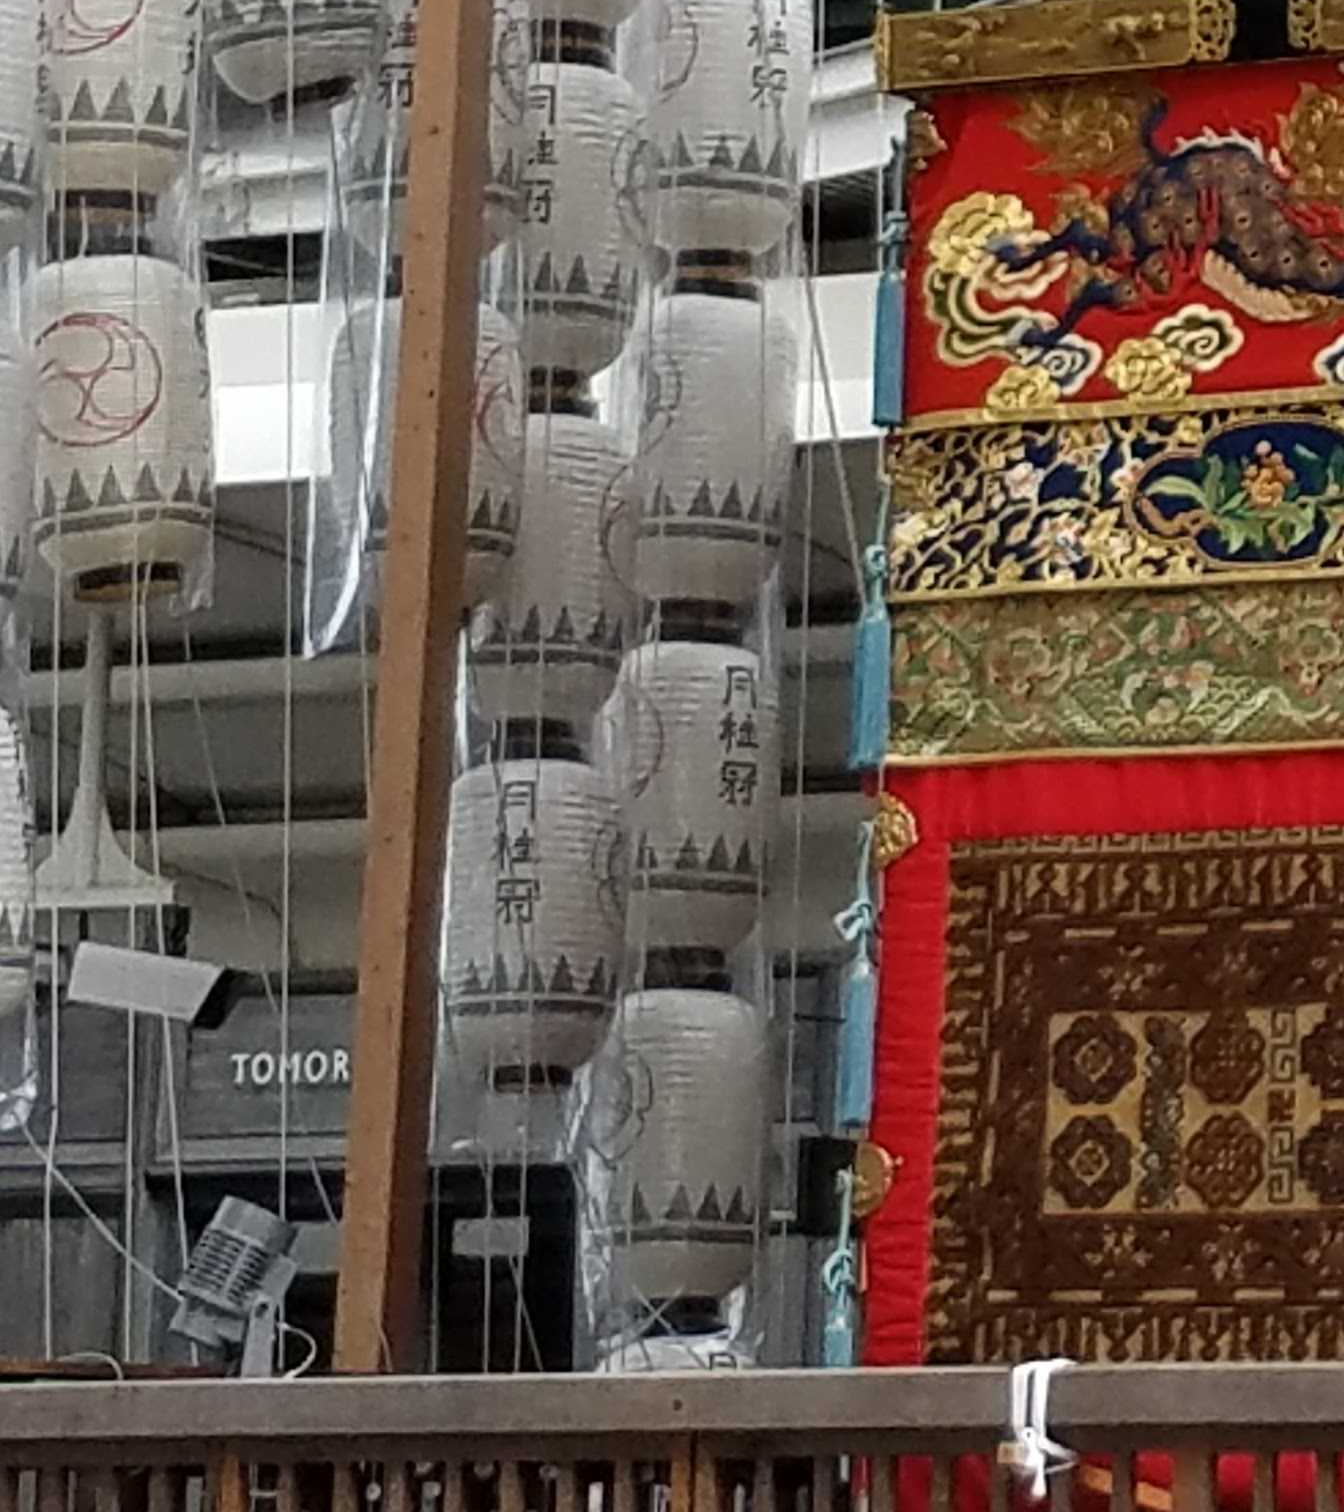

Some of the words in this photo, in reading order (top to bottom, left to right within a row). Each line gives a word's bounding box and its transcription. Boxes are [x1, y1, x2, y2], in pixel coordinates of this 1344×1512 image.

[719, 664, 761, 807] 月桂冠
[491, 779, 543, 924] 月桂冠
